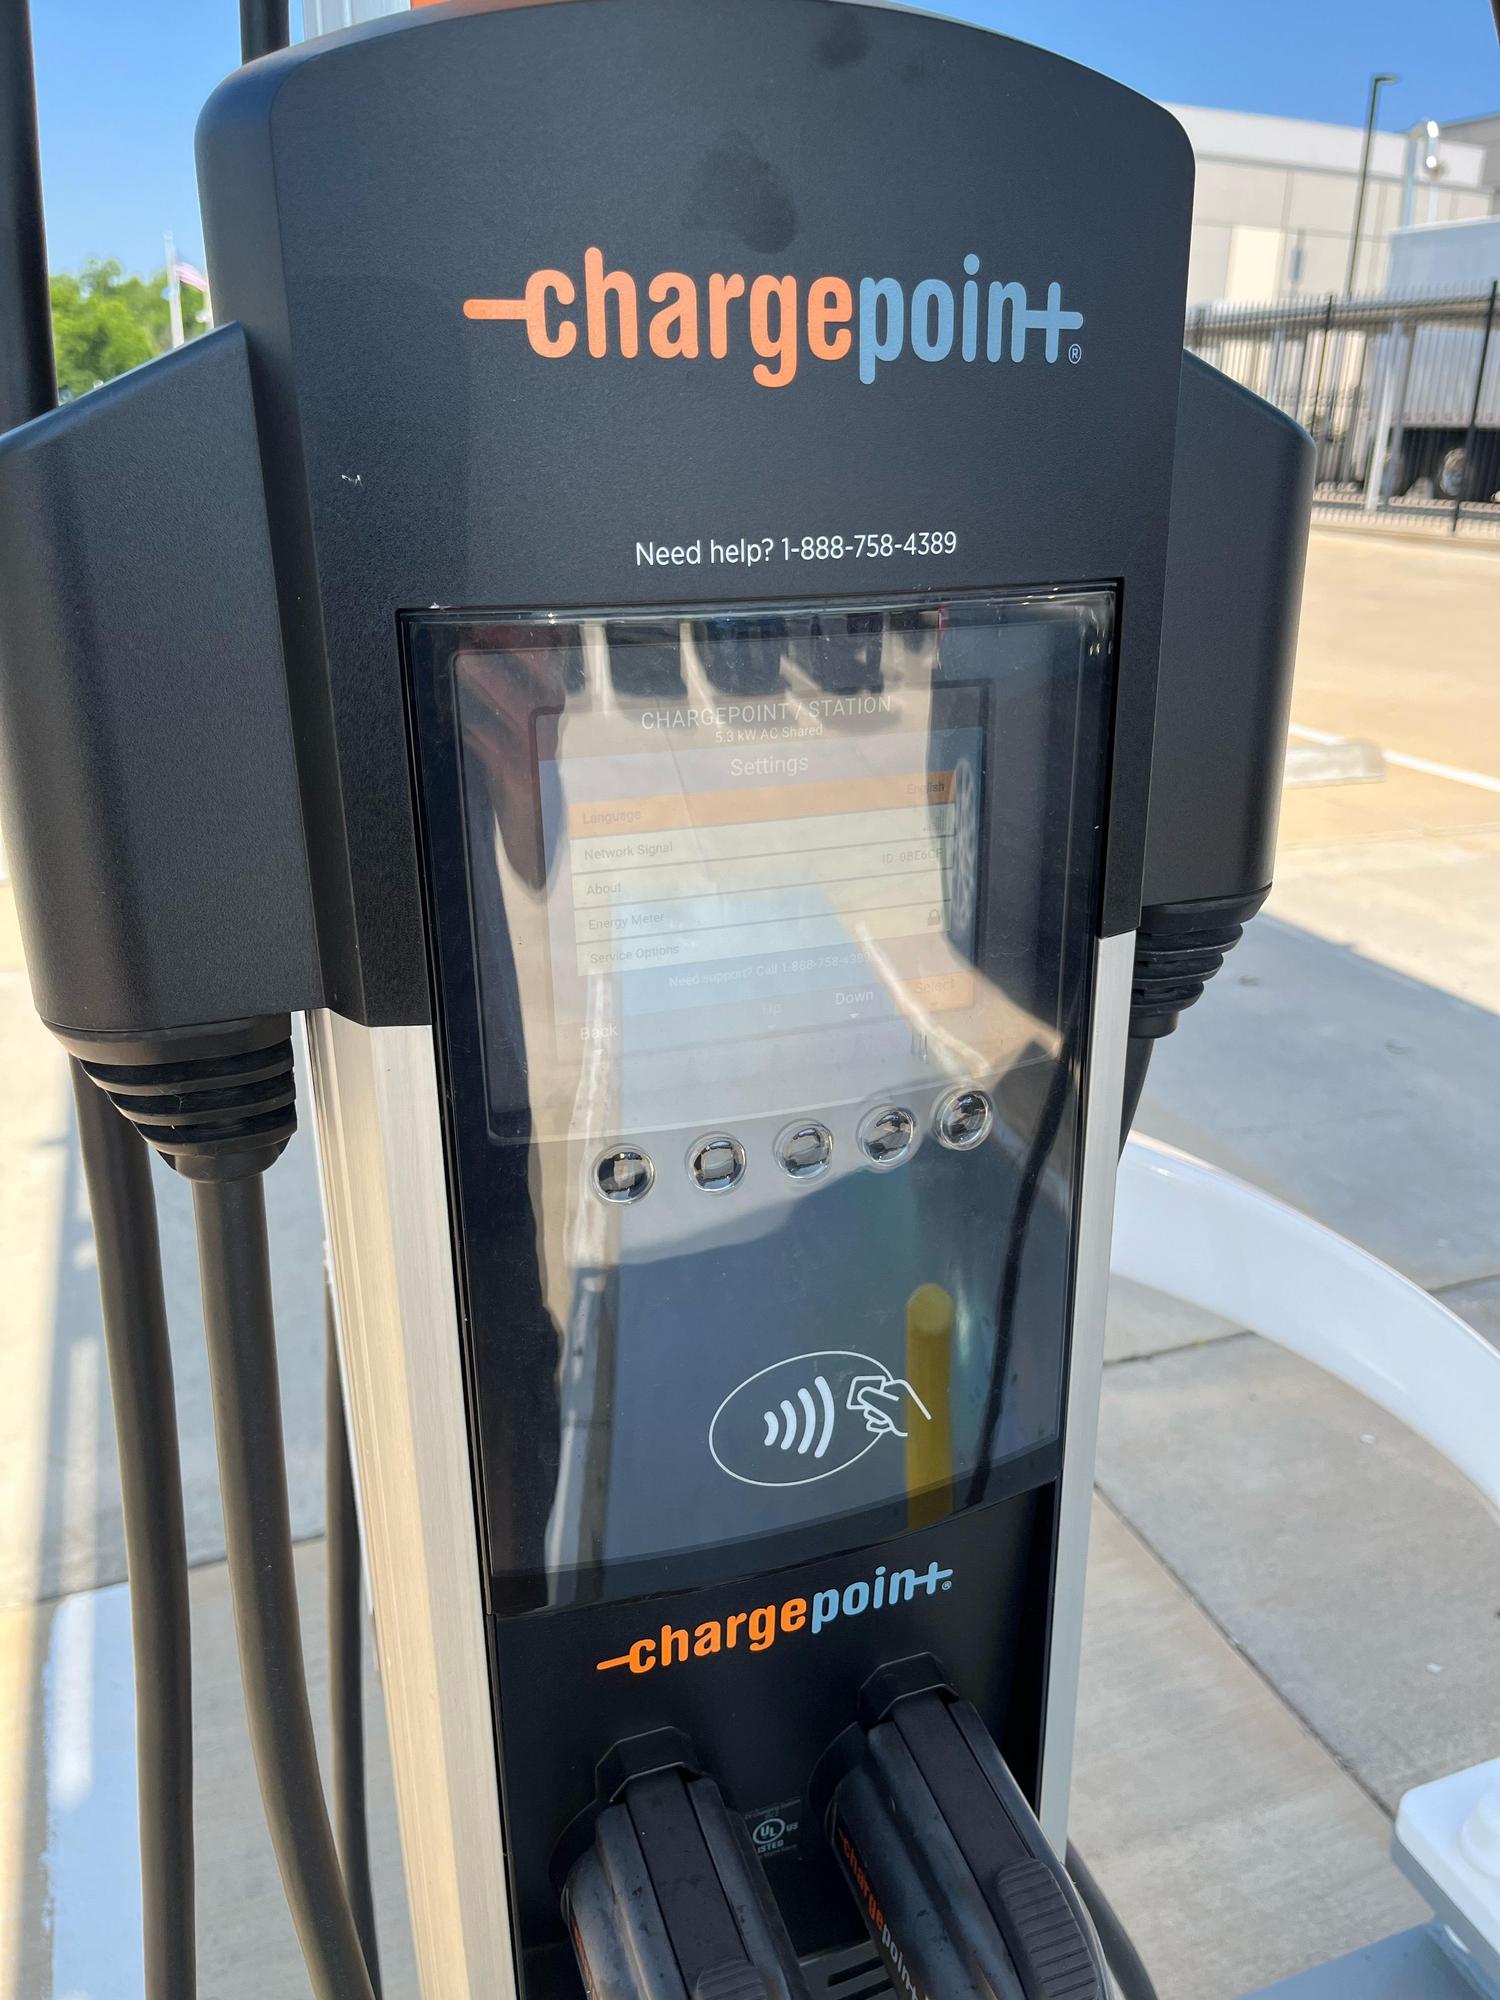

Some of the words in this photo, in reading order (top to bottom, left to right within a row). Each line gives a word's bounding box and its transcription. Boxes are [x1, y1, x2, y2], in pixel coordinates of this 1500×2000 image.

[635, 541, 701, 566] Need
[710, 537, 774, 567] help?
[780, 531, 957, 561] 1-888-758-4389
[641, 703, 790, 730] CHARGEPOINT
[808, 695, 892, 719] STATION
[714, 731, 735, 744] 5.3
[738, 729, 757, 741] kW
[760, 727, 779, 740] AC
[782, 723, 824, 738] Shared
[729, 756, 809, 778] Settings
[582, 810, 641, 826] Language
[584, 846, 634, 861] Network
[637, 841, 673, 857] Signal
[586, 882, 622, 896] About
[588, 916, 628, 931] Energy
[631, 912, 665, 925] Meter
[590, 951, 633, 965] Service
[635, 945, 680, 960] Options
[669, 974, 700, 989] Need
[915, 979, 956, 994] Select
[835, 989, 875, 1006] Down
[580, 1023, 618, 1041] Back
[757, 1839, 784, 1854] ISTED
